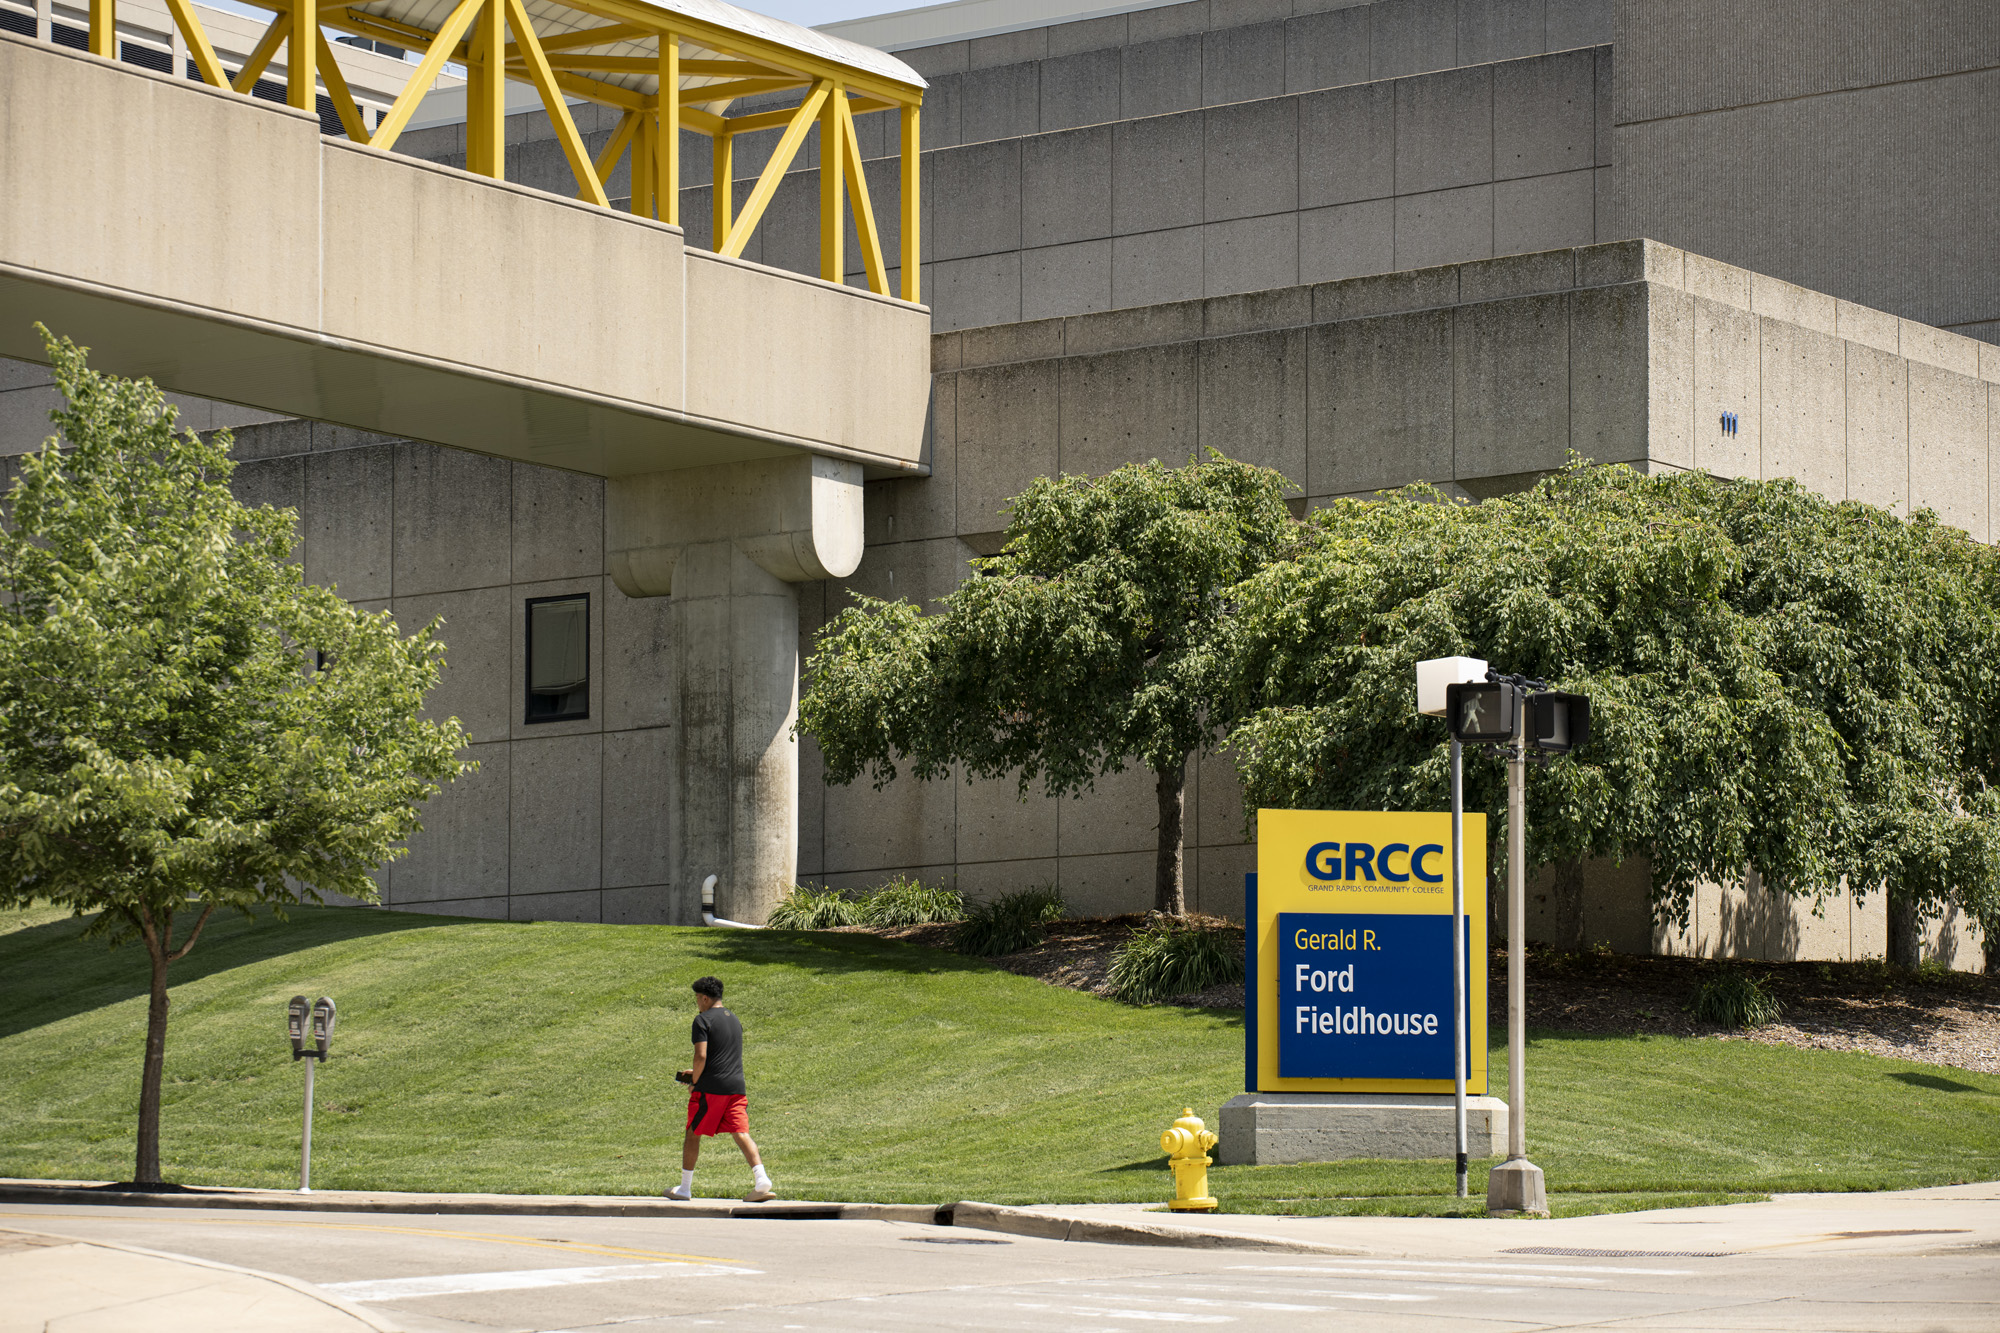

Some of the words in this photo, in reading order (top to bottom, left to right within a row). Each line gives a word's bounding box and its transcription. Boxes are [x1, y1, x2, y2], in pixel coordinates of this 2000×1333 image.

[1721, 410, 1739, 434] 111
[1305, 841, 1444, 883] GRCC
[1308, 884, 1334, 892] GRAND
[1336, 885, 1362, 893] RAPIDS
[1412, 886, 1445, 894] COLLEGE
[1294, 928, 1357, 951] Gerald
[1363, 929, 1382, 951] R.
[1295, 963, 1354, 993] Ford
[1295, 1005, 1439, 1036] Fieldhouse
